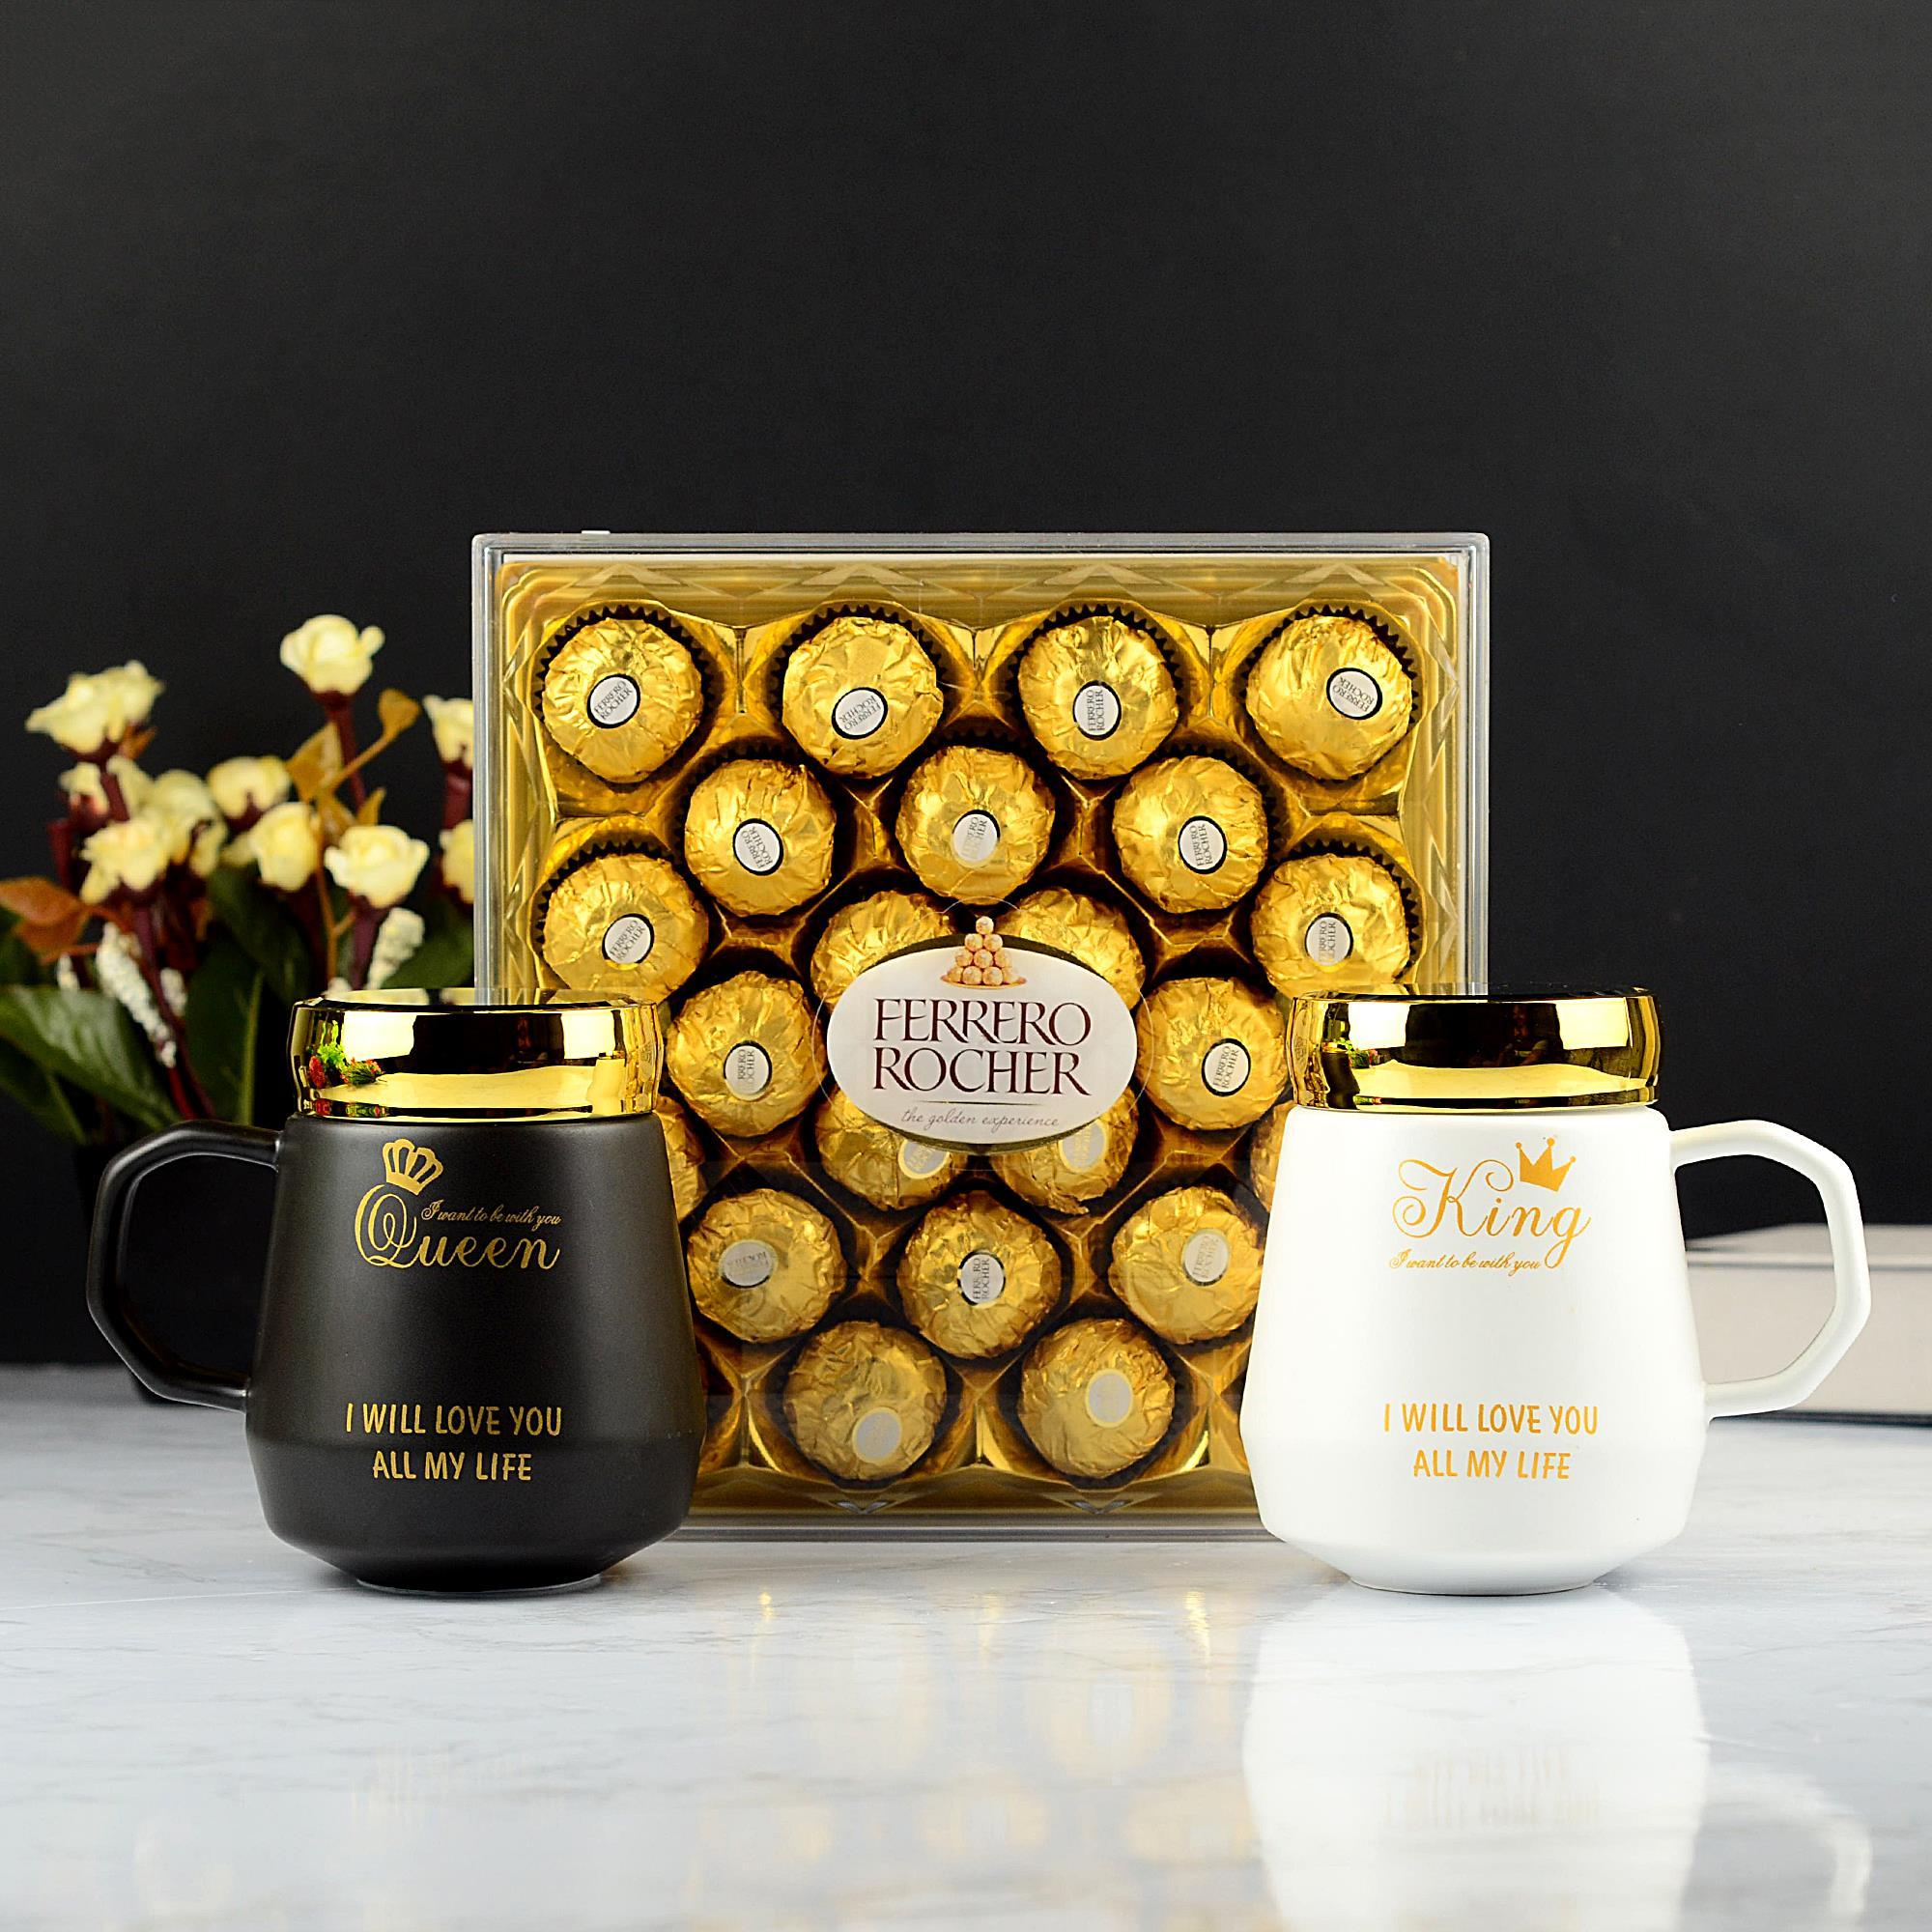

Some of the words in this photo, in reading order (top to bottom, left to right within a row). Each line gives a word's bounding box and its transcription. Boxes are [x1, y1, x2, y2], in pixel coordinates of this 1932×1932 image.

[593, 680, 626, 714] FERRERO
[600, 688, 633, 721] ROCHER
[1332, 684, 1369, 712] FERRERO
[1340, 676, 1375, 703] ROCHER
[839, 695, 877, 723] ROCHER
[843, 702, 881, 730] FERRERO
[1088, 689, 1096, 731] FERRERO
[1095, 689, 1105, 731] ROCHER
[741, 830, 765, 868] FERRERO
[749, 826, 773, 866] ROCHER
[1189, 825, 1204, 867] FERRERO
[1198, 823, 1212, 865] ROCHER
[610, 920, 638, 955] FERRERO
[616, 925, 645, 960] ROCHER
[873, 998, 1092, 1046] FERRERO
[873, 1046, 1092, 1096] ROCHER
[1212, 1045, 1230, 1087] FERRERO
[1222, 1049, 1238, 1089] ROCHER
[900, 1106, 923, 1122] the
[923, 1108, 976, 1130] golden
[981, 1117, 1059, 1133] experience
[355, 1183, 560, 1269] Queen
[421, 1199, 444, 1220] I
[437, 1207, 476, 1221] want
[473, 1207, 488, 1221] to
[489, 1204, 503, 1222] be
[505, 1206, 540, 1223] with
[531, 1214, 561, 1232] you
[1392, 1158, 1591, 1269] King
[981, 1258, 990, 1300] ROCHER
[1389, 1248, 1412, 1268] I
[1406, 1254, 1446, 1268] want
[1444, 1254, 1460, 1268] to
[1461, 1251, 1477, 1268] be
[1479, 1251, 1515, 1268] with
[1508, 1260, 1541, 1277] you
[346, 1403, 353, 1433] I
[362, 1403, 426, 1434] WILL
[436, 1405, 500, 1435] LOVE
[509, 1406, 562, 1435] YOU
[1383, 1403, 1390, 1432] I
[1402, 1403, 1468, 1433] WILL
[1478, 1404, 1542, 1434] LOVE
[1548, 1405, 1598, 1435] YOU
[373, 1450, 416, 1479] ALL
[424, 1451, 465, 1480] MY
[476, 1452, 531, 1481] LIFE
[1413, 1449, 1458, 1477] ALL
[1466, 1450, 1507, 1478] MY
[1517, 1451, 1571, 1479] LIFE
